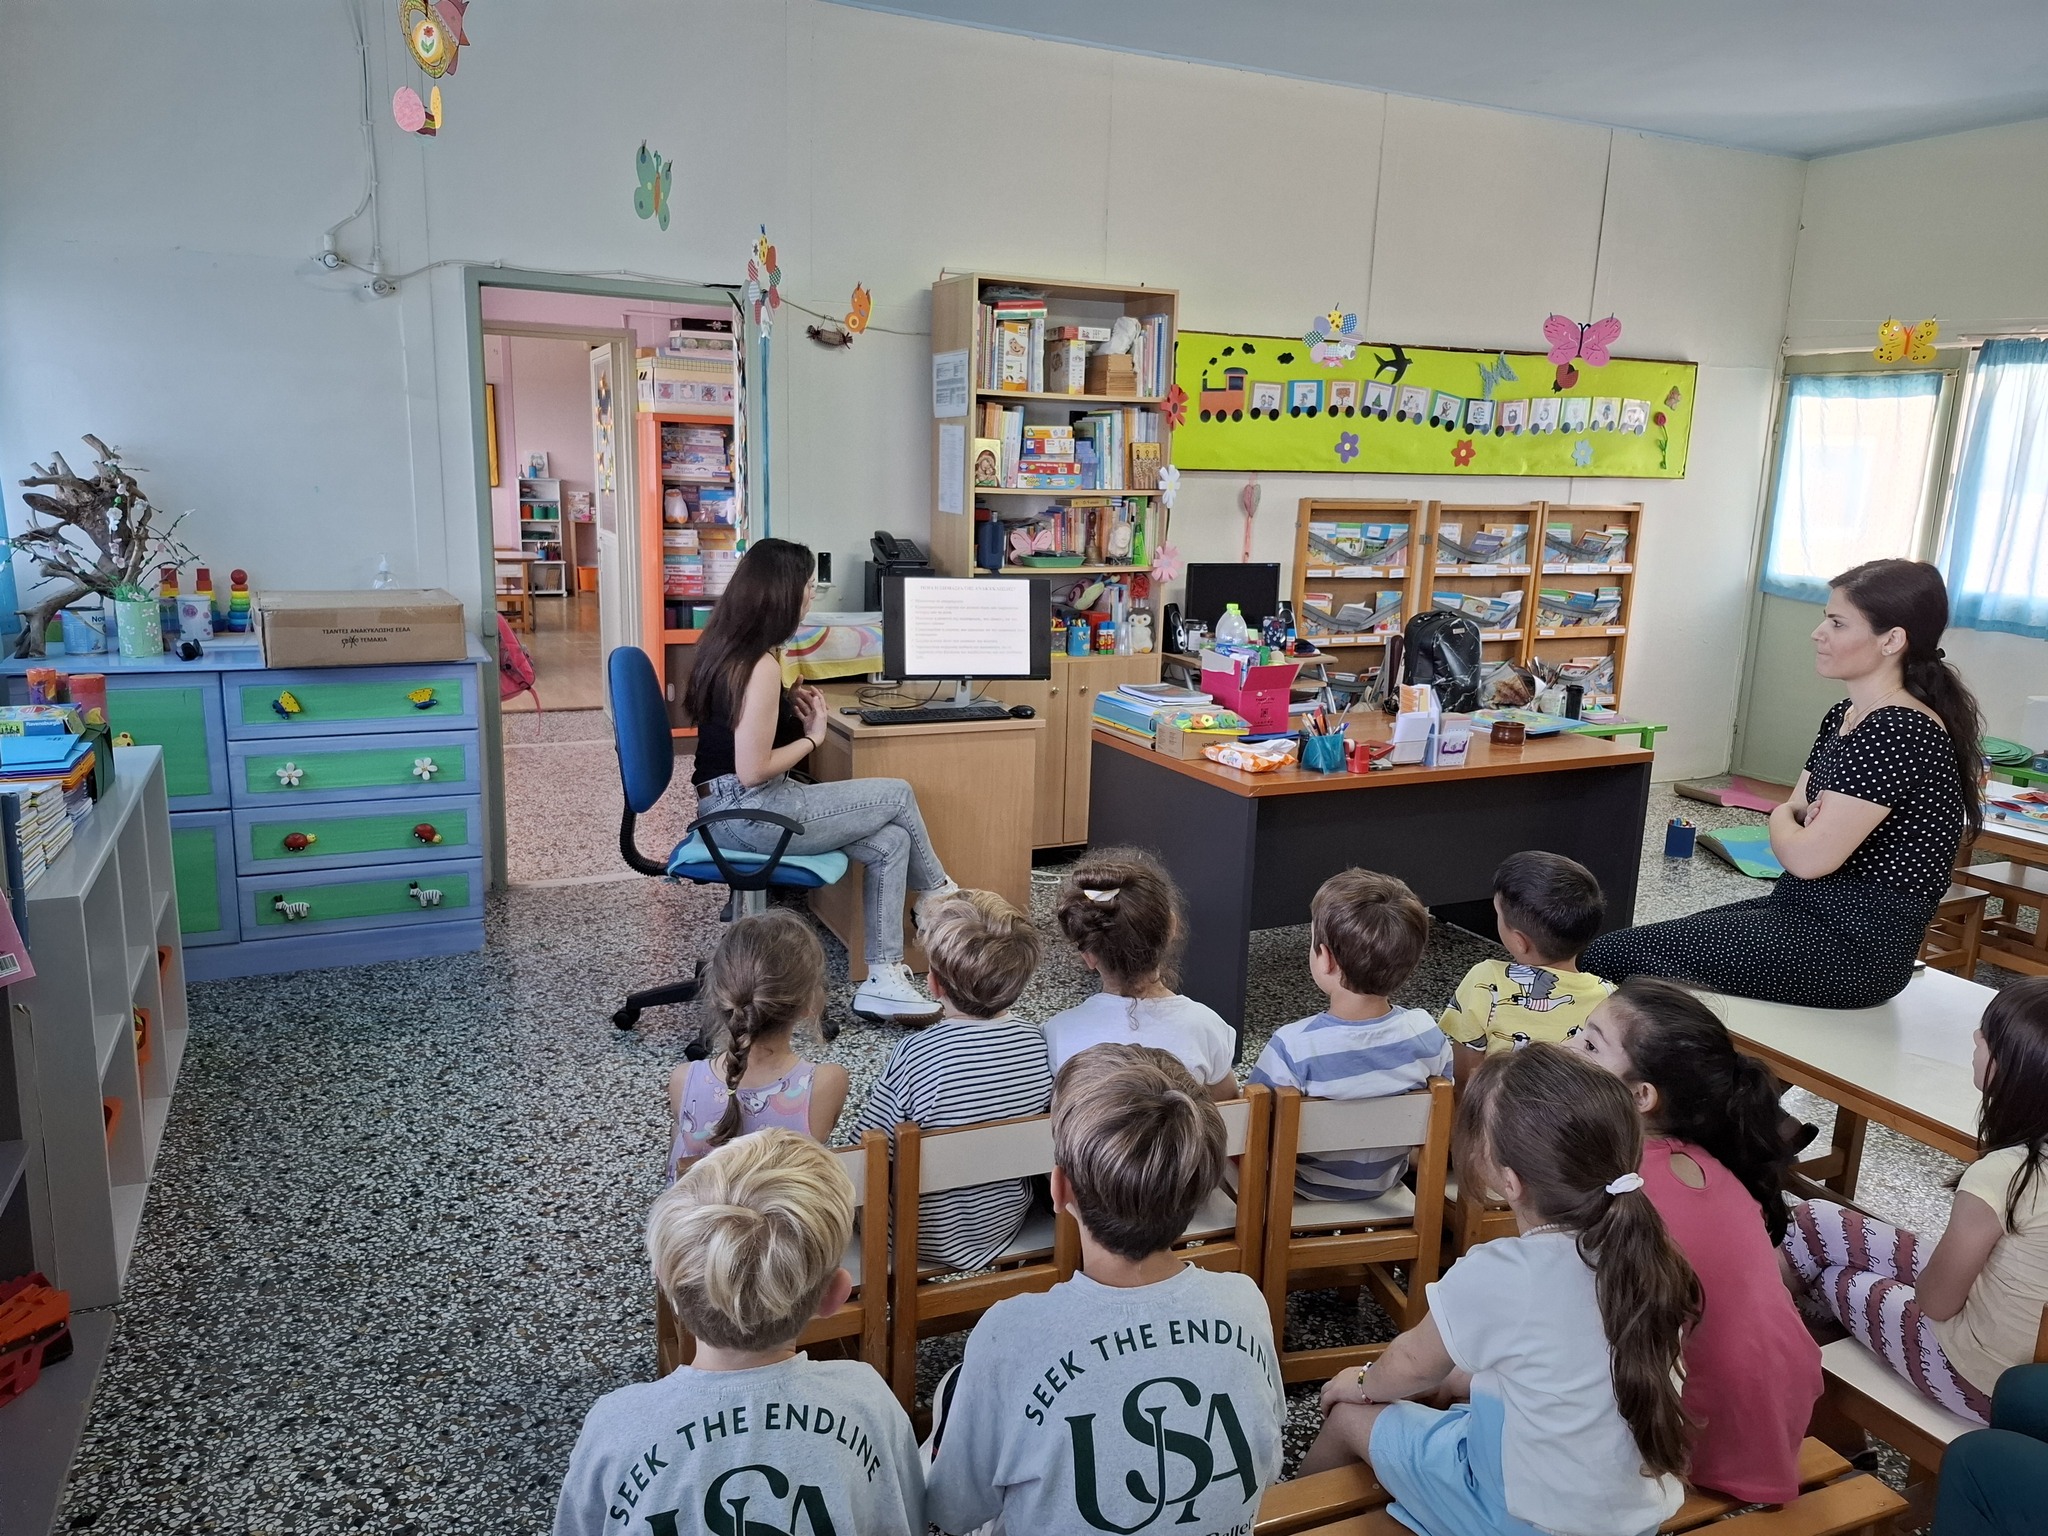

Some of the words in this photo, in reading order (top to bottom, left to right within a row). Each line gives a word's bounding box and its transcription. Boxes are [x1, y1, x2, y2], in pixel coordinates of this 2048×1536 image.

[1025, 1350, 1085, 1426] SEEK
[1090, 1323, 1157, 1361] THE
[610, 1443, 669, 1526] SEEK
[676, 1406, 749, 1450] THE
[765, 1403, 881, 1482] ENDLINE
[1064, 1376, 1258, 1535] USA
